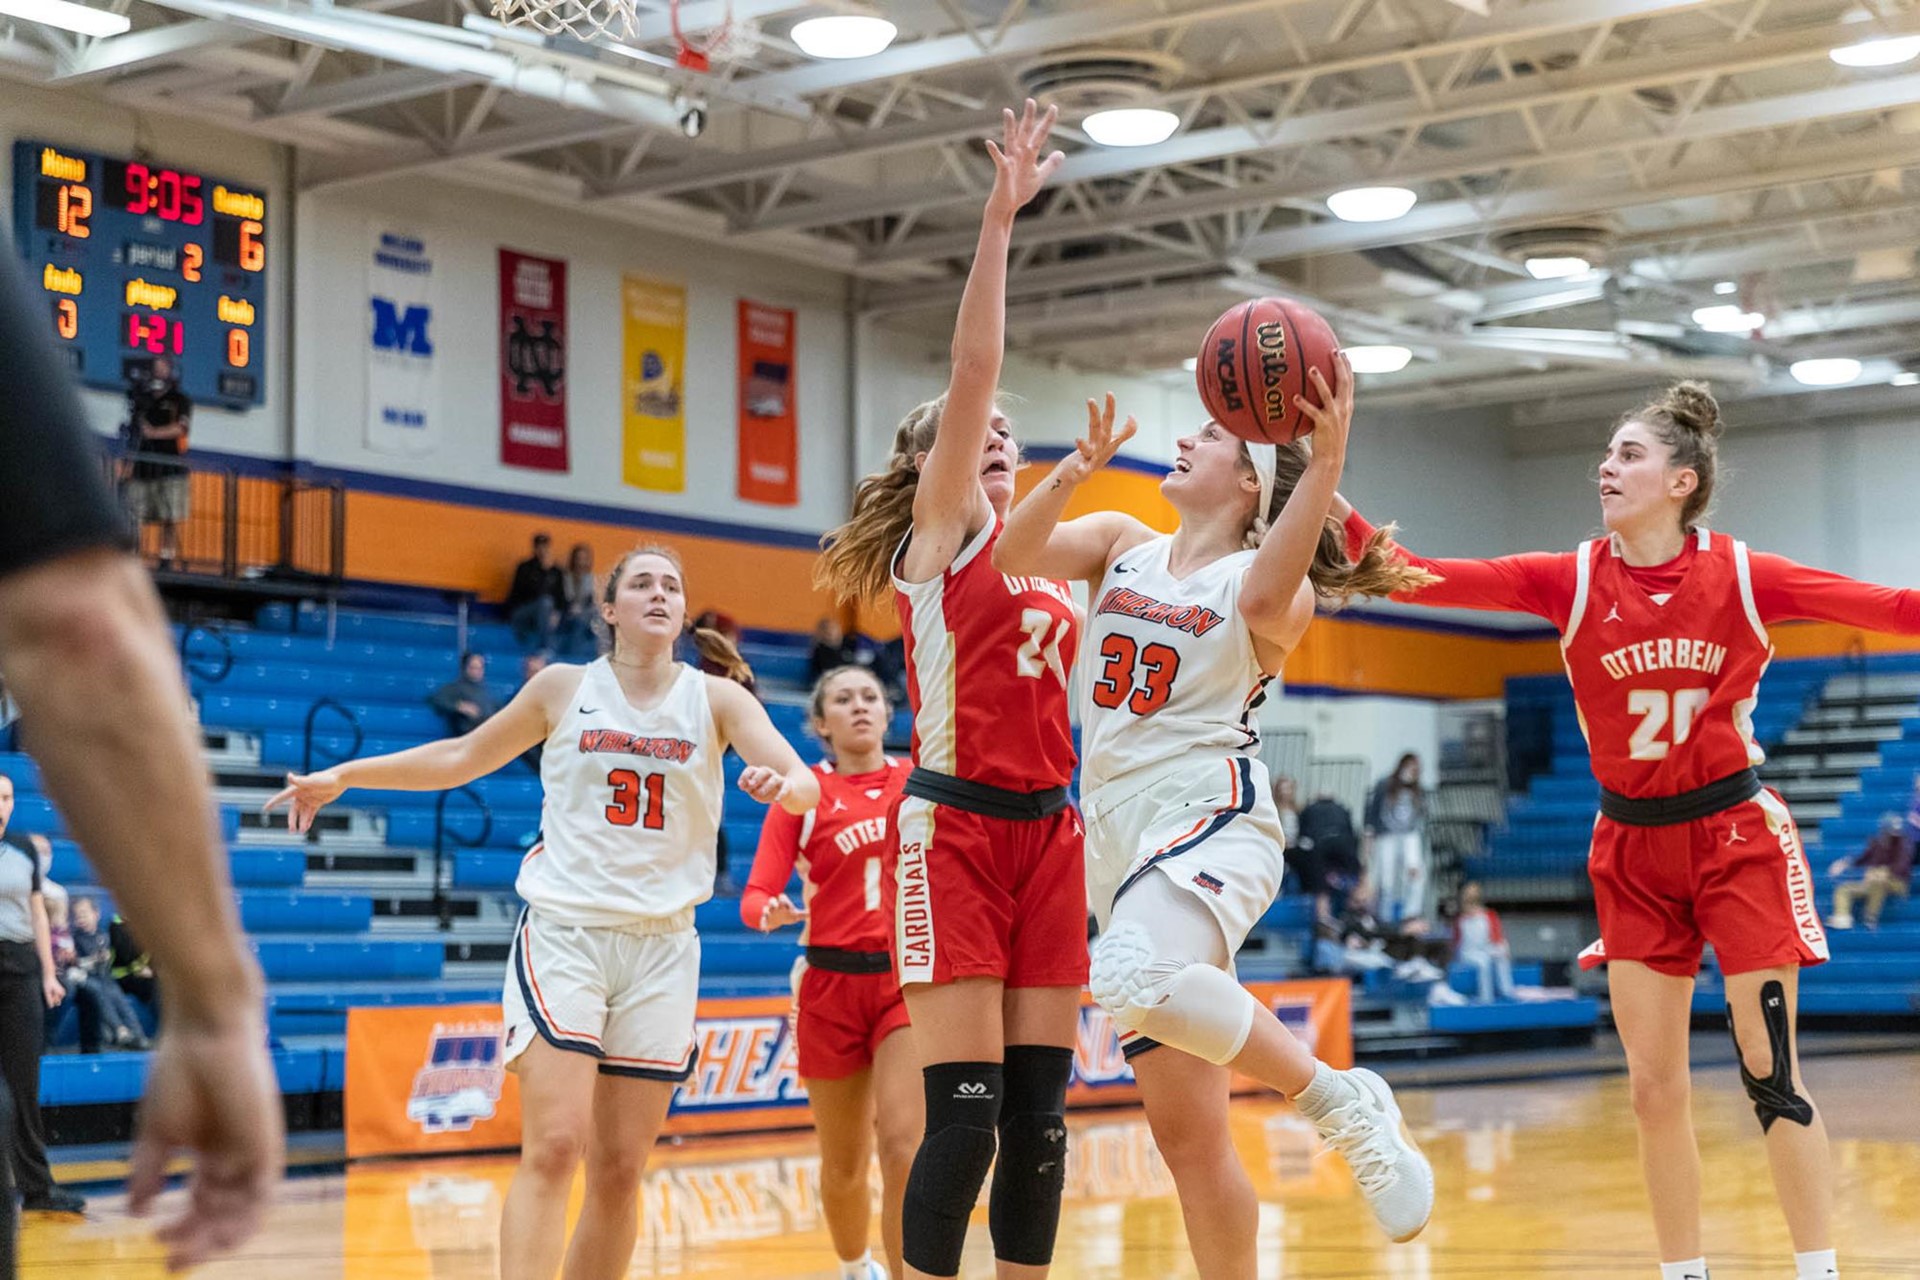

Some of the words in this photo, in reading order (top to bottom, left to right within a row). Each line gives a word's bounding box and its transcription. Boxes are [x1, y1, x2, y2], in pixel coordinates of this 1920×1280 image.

[58, 184, 93, 238] 12
[125, 161, 204, 226] 9:05
[182, 242, 204, 283] 2
[239, 219, 265, 272] 6
[228, 328, 249, 368] 0
[371, 297, 432, 357] M
[1216, 338, 1244, 412] NCAA
[1255, 321, 1288, 424] Wilson
[1093, 632, 1181, 716] 33
[1600, 638, 1727, 680] OTTERBEIN
[579, 729, 697, 764] WHEATON
[605, 768, 665, 830] 31
[902, 842, 931, 967] CARDINALS
